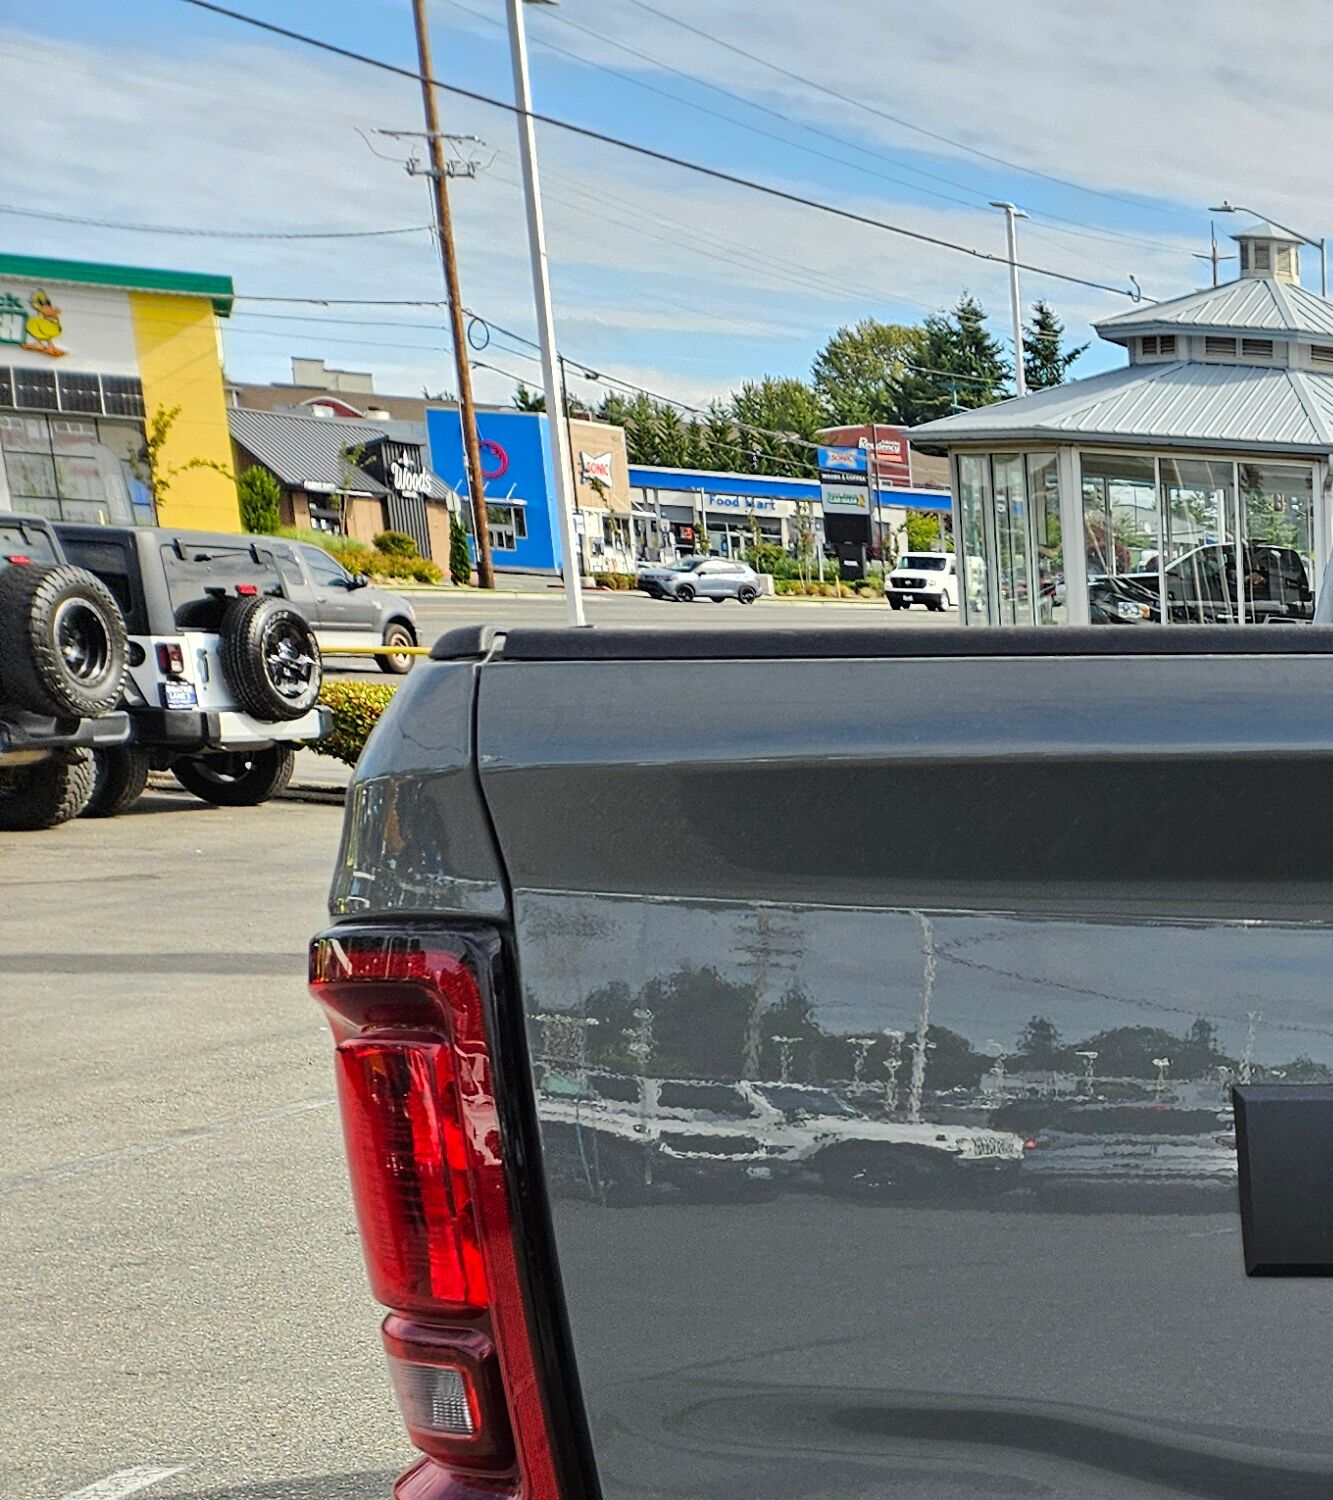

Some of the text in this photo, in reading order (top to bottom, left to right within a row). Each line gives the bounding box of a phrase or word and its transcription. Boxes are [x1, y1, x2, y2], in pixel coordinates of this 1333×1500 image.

[586, 461, 609, 476] SONIC
[391, 461, 433, 493] Woods
[709, 492, 739, 507] Food
